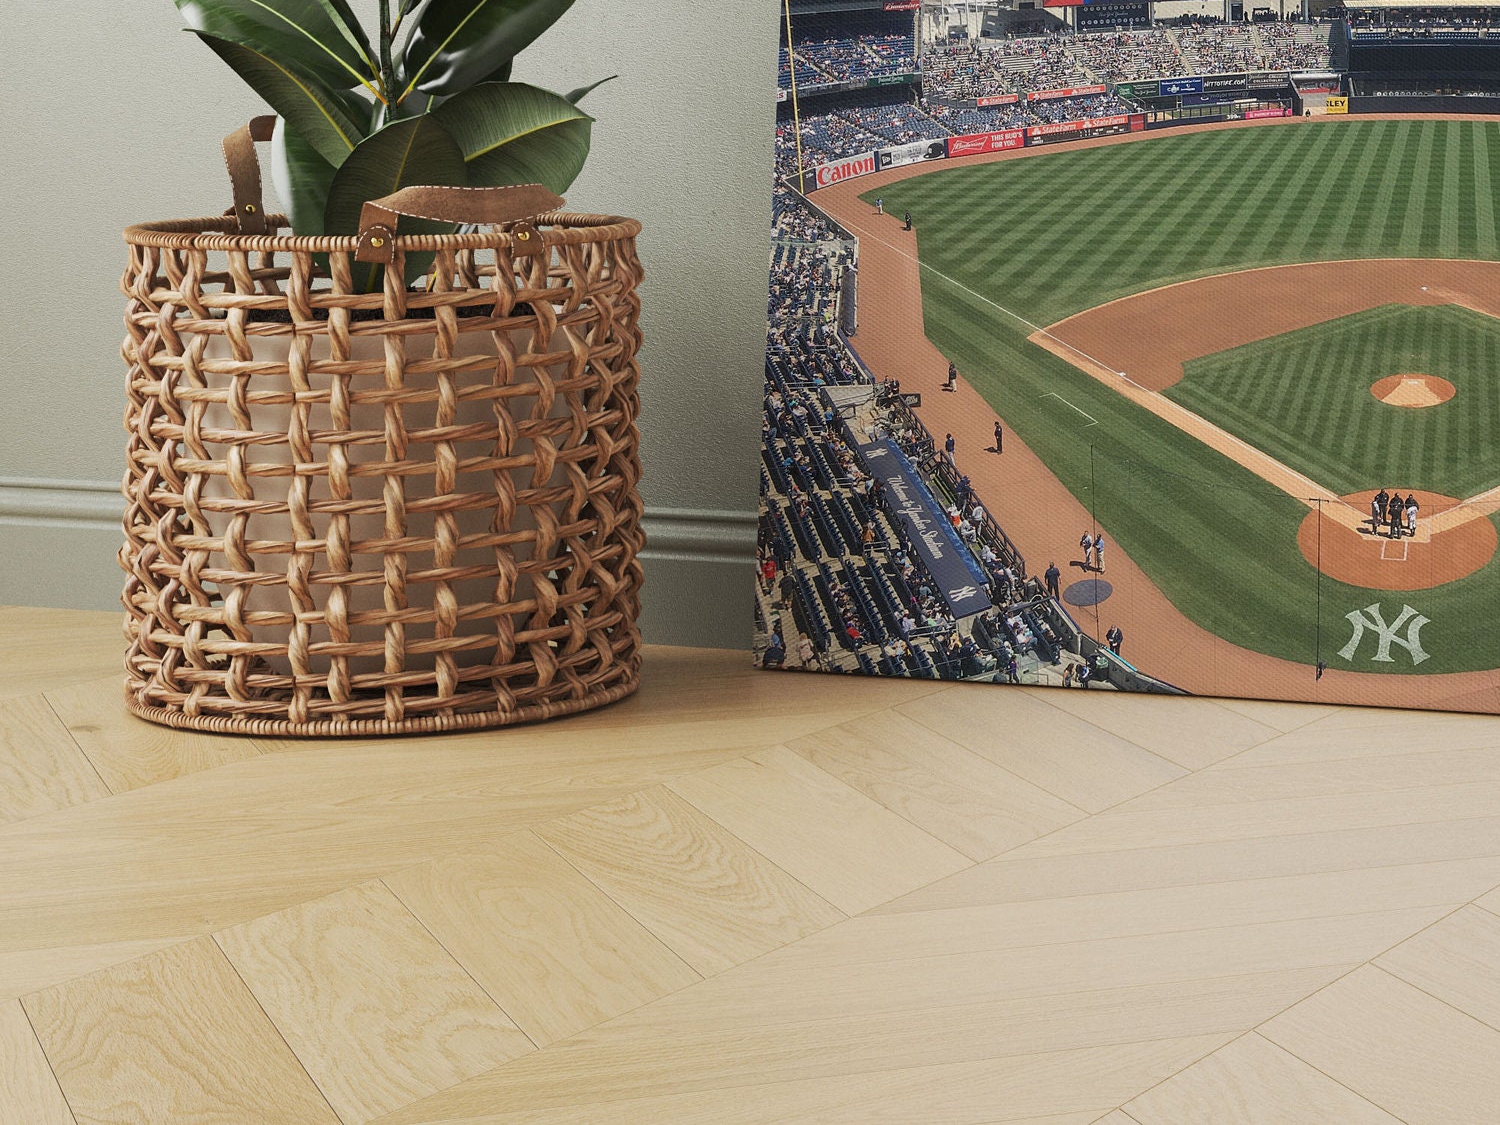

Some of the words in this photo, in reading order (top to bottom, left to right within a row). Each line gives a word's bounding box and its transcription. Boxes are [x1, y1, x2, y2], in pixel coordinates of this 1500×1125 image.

[817, 156, 875, 186] Canon
[897, 504, 931, 530] Yankee
[919, 530, 944, 559] Stadium
